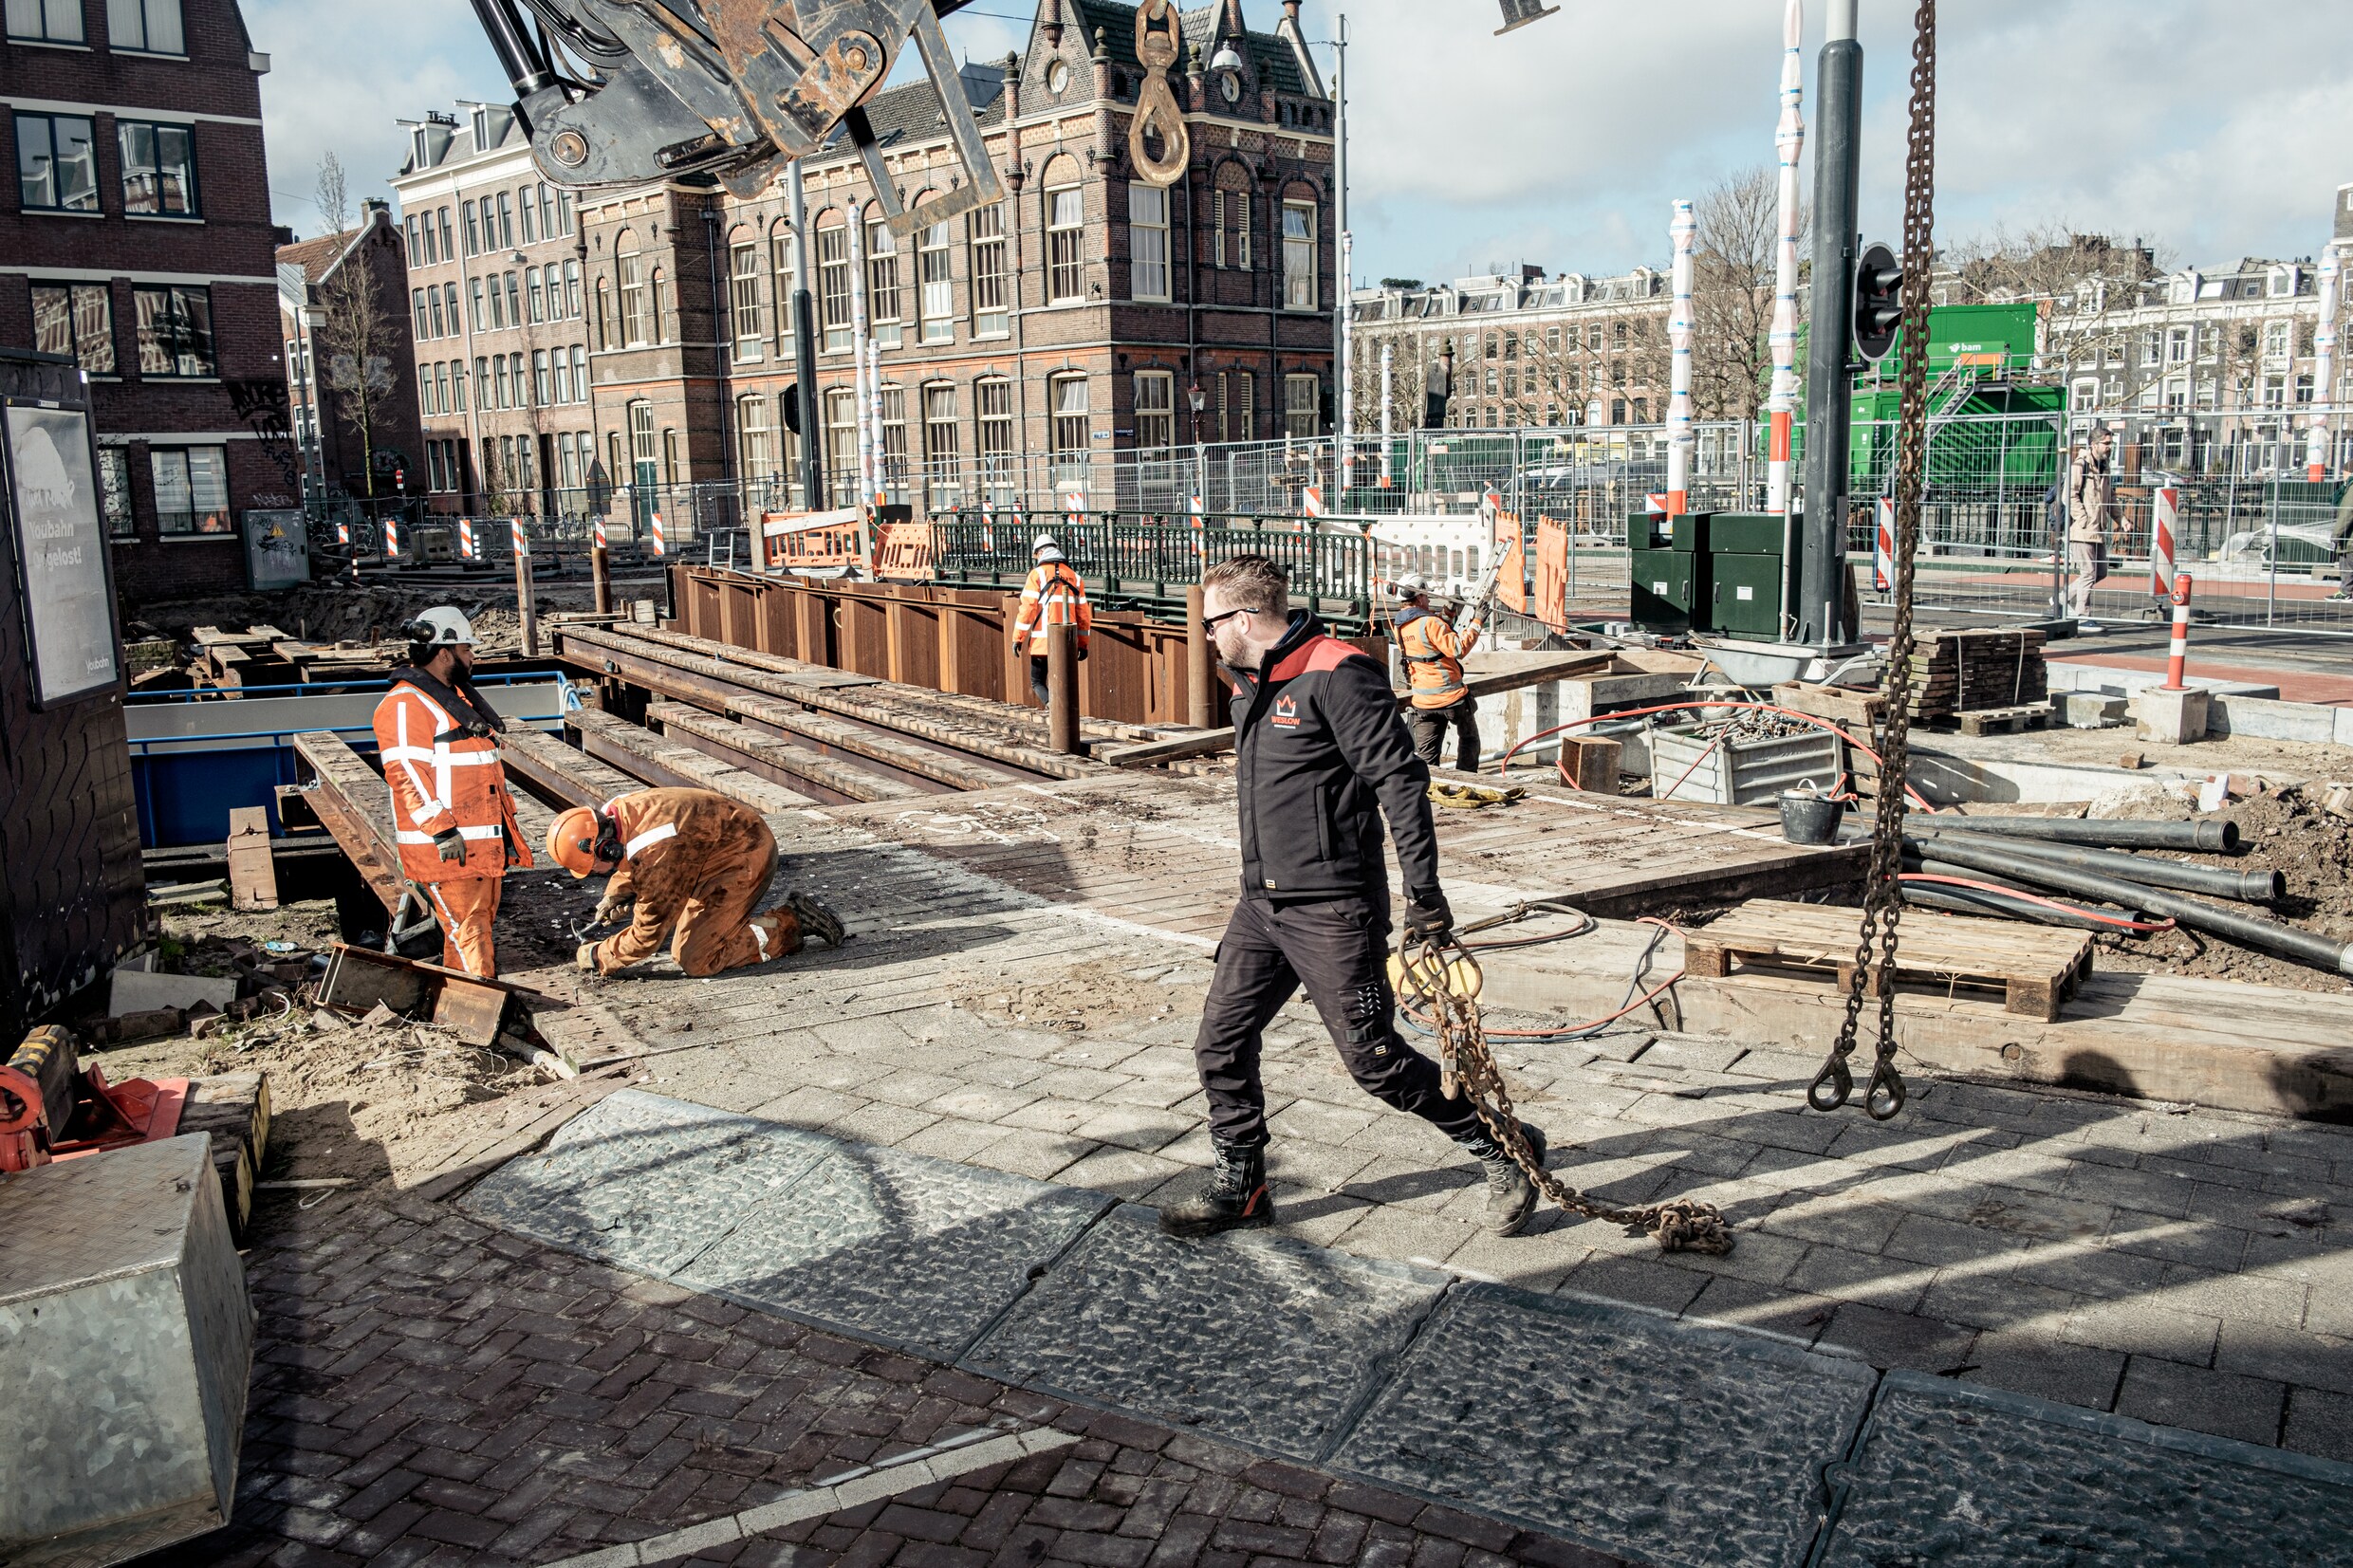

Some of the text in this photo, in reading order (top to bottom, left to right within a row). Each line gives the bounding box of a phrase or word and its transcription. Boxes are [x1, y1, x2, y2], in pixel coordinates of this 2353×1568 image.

[1961, 342, 1981, 351] bam
[28, 519, 74, 539] Youbahn
[1271, 715, 1301, 726] WESLOW
